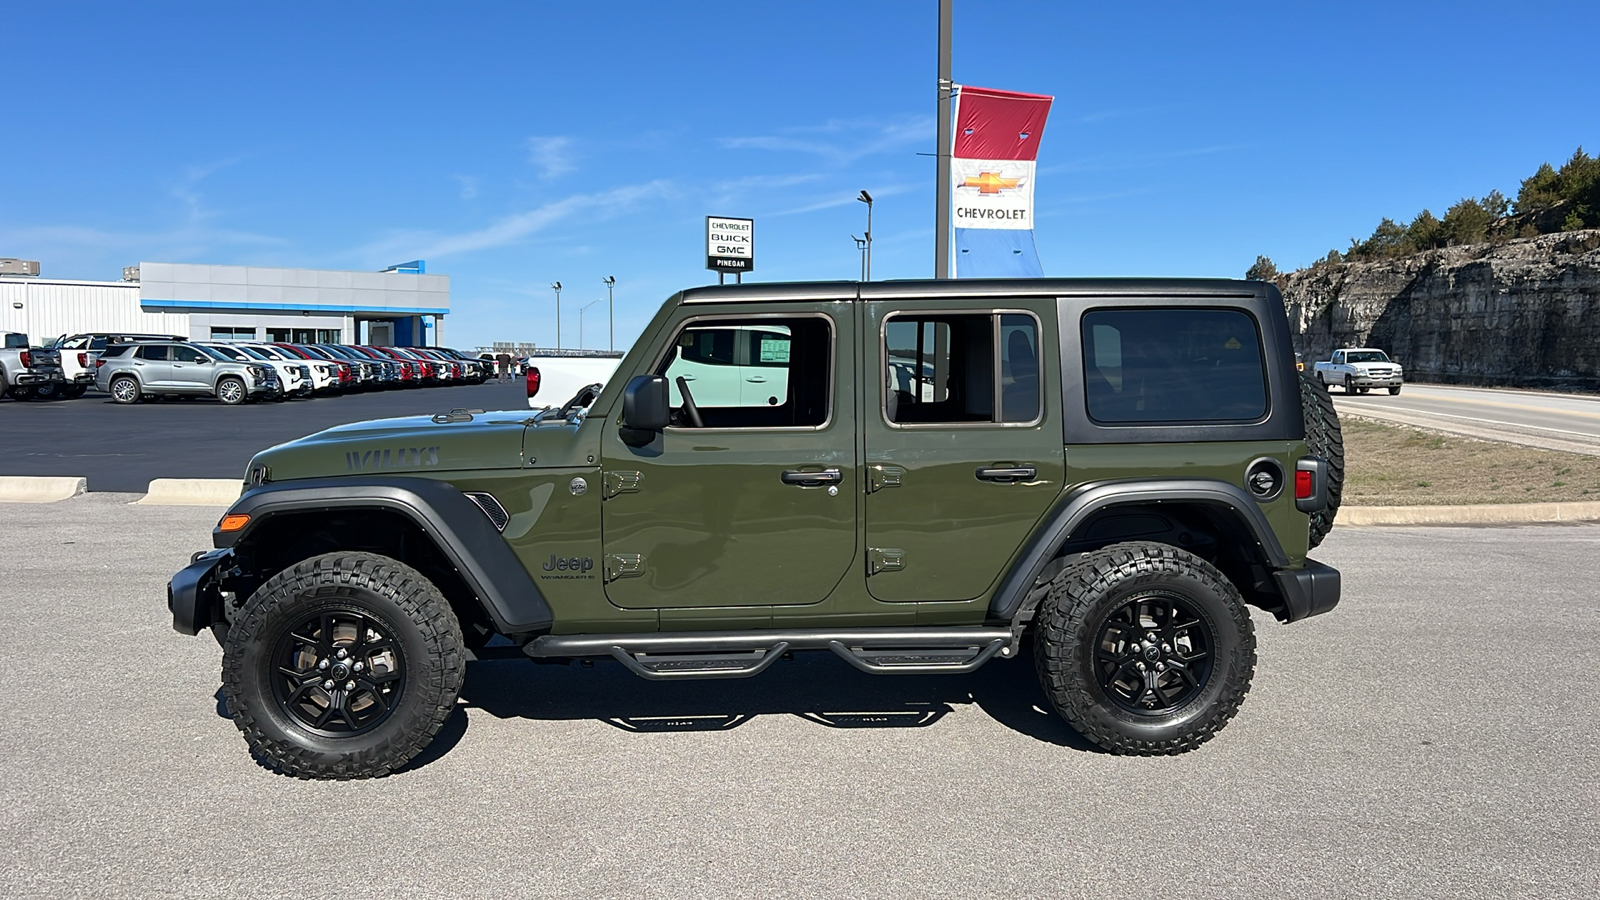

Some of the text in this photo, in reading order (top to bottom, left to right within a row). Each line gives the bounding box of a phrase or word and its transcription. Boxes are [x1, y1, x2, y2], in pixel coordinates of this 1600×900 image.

[957, 207, 1026, 220] CHEVROLET
[711, 222, 749, 231] CHEVROLET
[711, 234, 749, 243] BUICK
[717, 246, 745, 254] GMC
[717, 259, 745, 267] PINEGAR
[346, 445, 441, 471] WILLYS
[542, 554, 593, 573] Jeep
